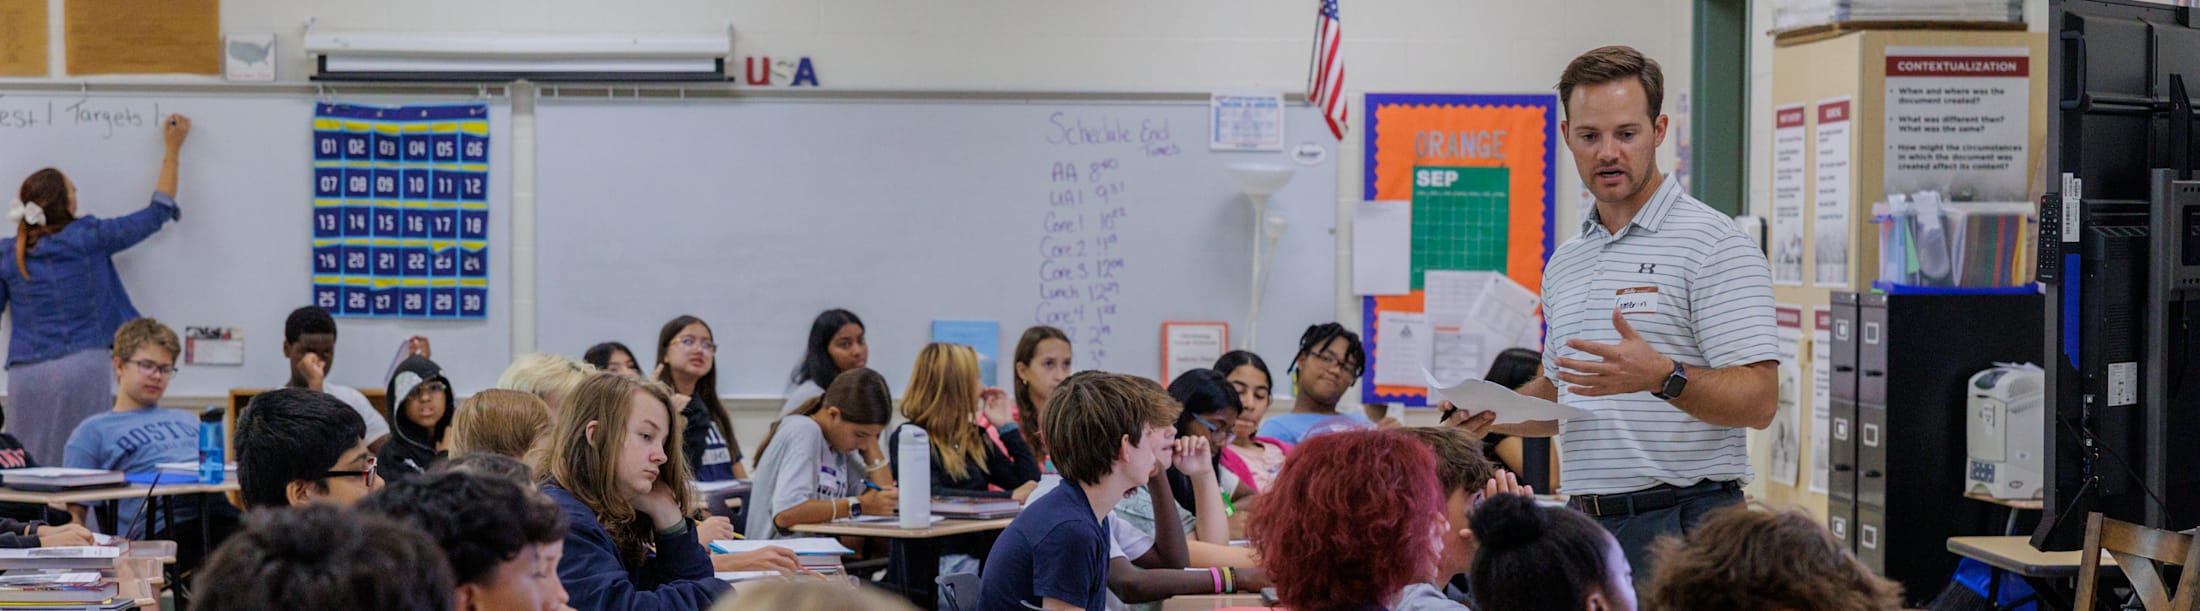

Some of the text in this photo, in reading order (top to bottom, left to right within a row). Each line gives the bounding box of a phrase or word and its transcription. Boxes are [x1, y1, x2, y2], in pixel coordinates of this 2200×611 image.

[746, 56, 819, 86] USA
[1897, 61, 2017, 72] CONTEXTUALIZATION
[66, 99, 143, 140] Targets
[1046, 112, 1169, 145] Schedule End
[322, 139, 483, 157] 01 02 03 04 05 06
[1414, 130, 1508, 160] ORANGE
[1919, 145, 1943, 153] might
[1052, 161, 1077, 182] AA
[1416, 169, 1459, 187] SEP
[321, 177, 480, 194] 07 08 09 10 11 12
[319, 215, 481, 233] 13 14 15 16 17 18
[1044, 210, 1074, 233] Core
[1040, 235, 1073, 258] Core
[1077, 240, 1087, 257] 2
[319, 254, 479, 270] 19 20 21 22 23 24
[1040, 259, 1072, 282] Core
[1078, 262, 1088, 279] 3
[1040, 283, 1079, 299] Lunch
[319, 292, 480, 310] 25 26 27 28 29 30
[1035, 302, 1074, 324] Core
[1074, 304, 1084, 320] 4
